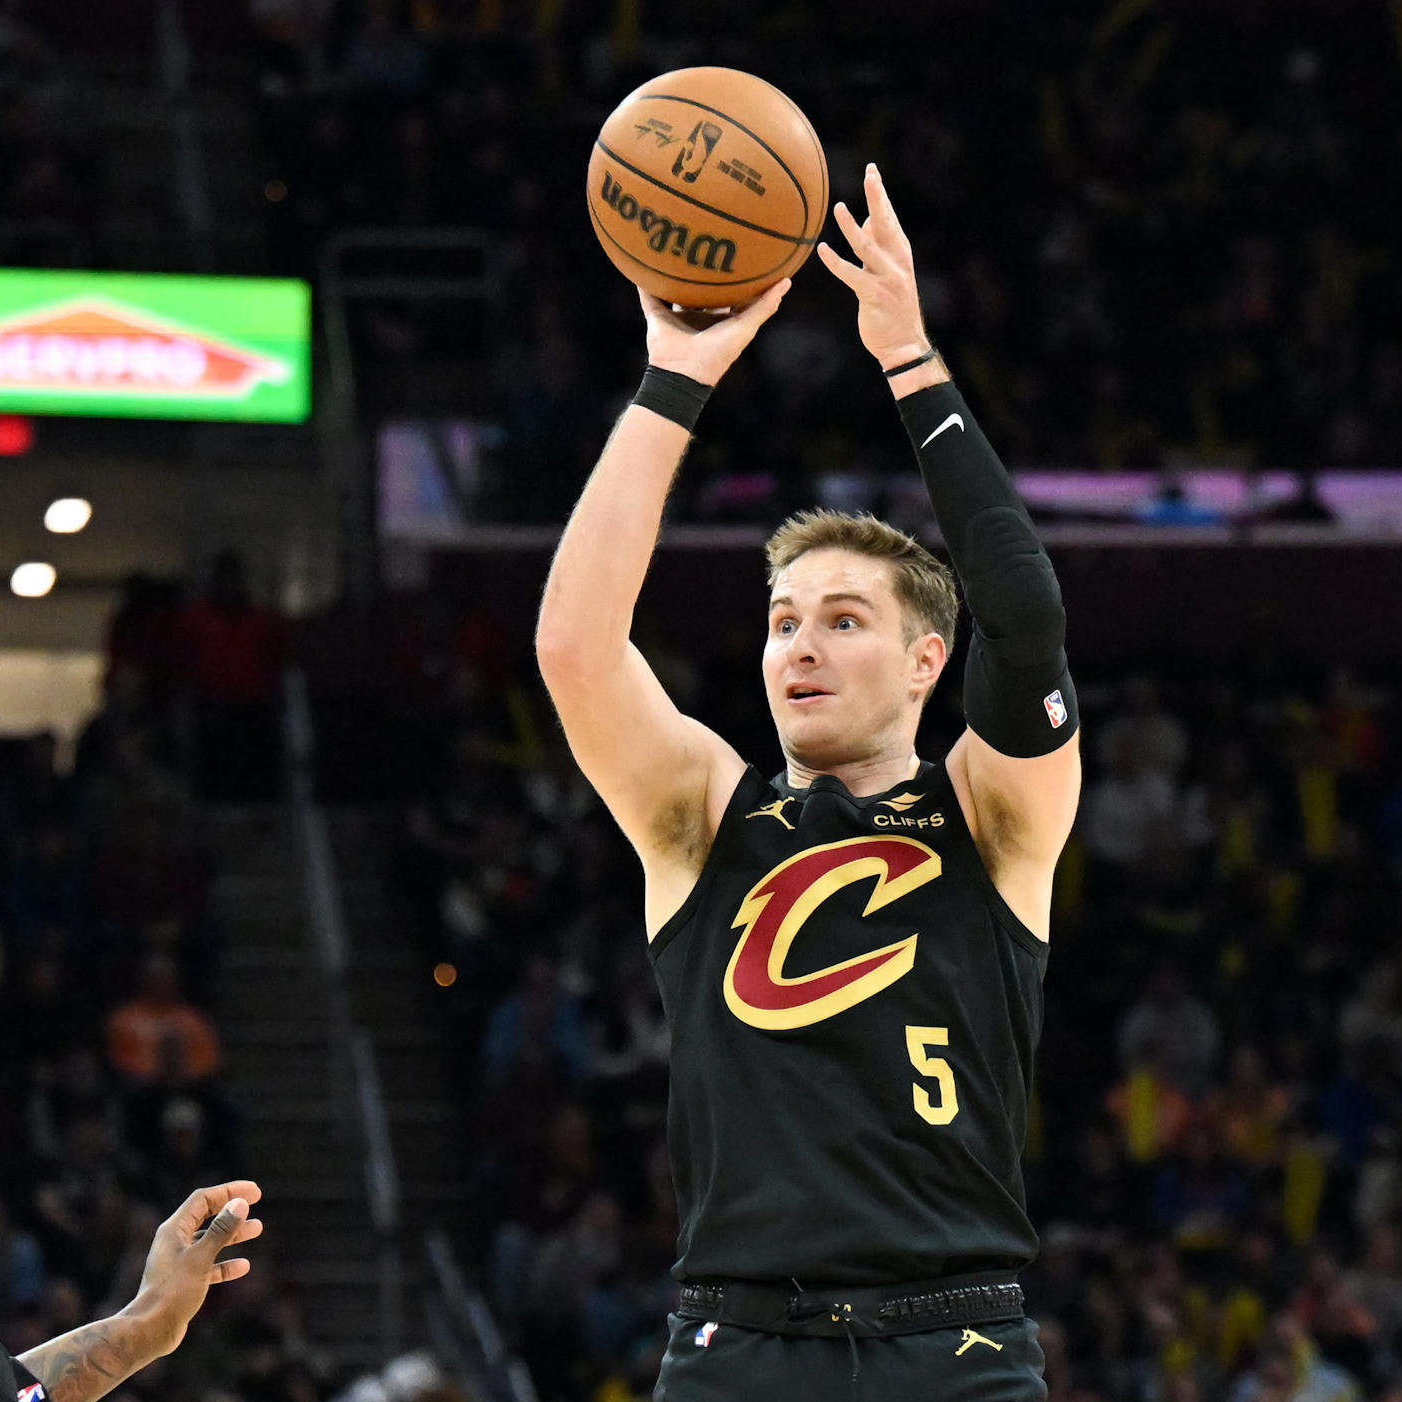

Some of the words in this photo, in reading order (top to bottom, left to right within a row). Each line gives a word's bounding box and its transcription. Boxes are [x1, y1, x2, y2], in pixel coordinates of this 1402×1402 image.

[601, 171, 737, 274] Wilson
[873, 812, 945, 829] CLIFFS
[723, 834, 943, 1031] C
[905, 1025, 959, 1126] 5
